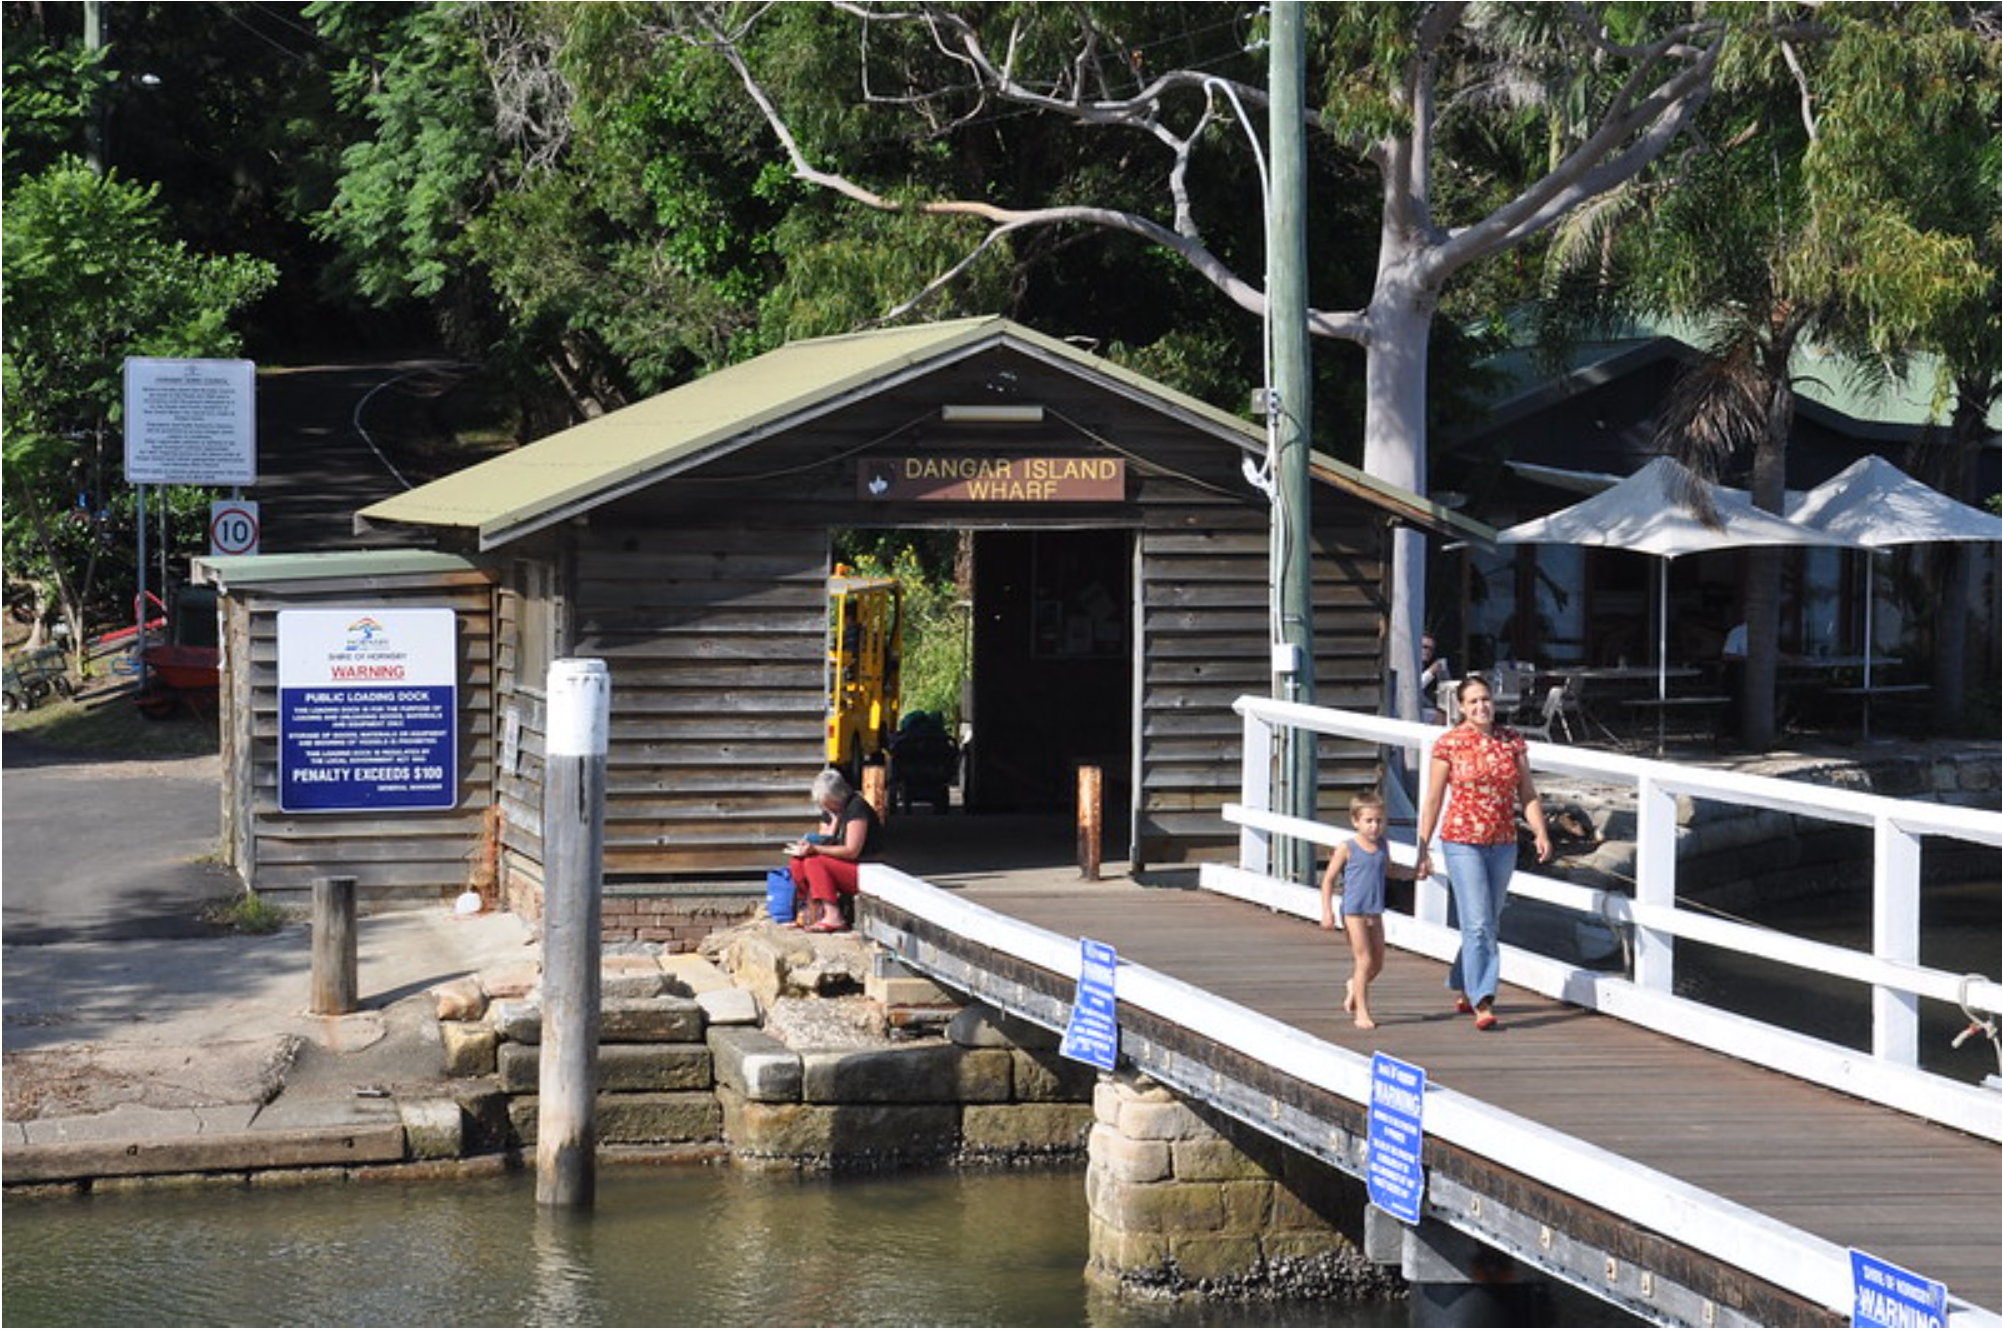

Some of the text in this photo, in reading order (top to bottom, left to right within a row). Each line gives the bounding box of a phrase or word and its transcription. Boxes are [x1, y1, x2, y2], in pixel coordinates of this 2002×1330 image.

[906, 458, 1116, 480] DANGAR ISLAND
[966, 480, 1059, 500] WHARF
[222, 520, 249, 544] 10
[331, 665, 405, 679] WARNING
[305, 691, 430, 702] PUBLIC LOADING DOCK
[292, 766, 443, 782] PENALTY EXCEEDS $100
